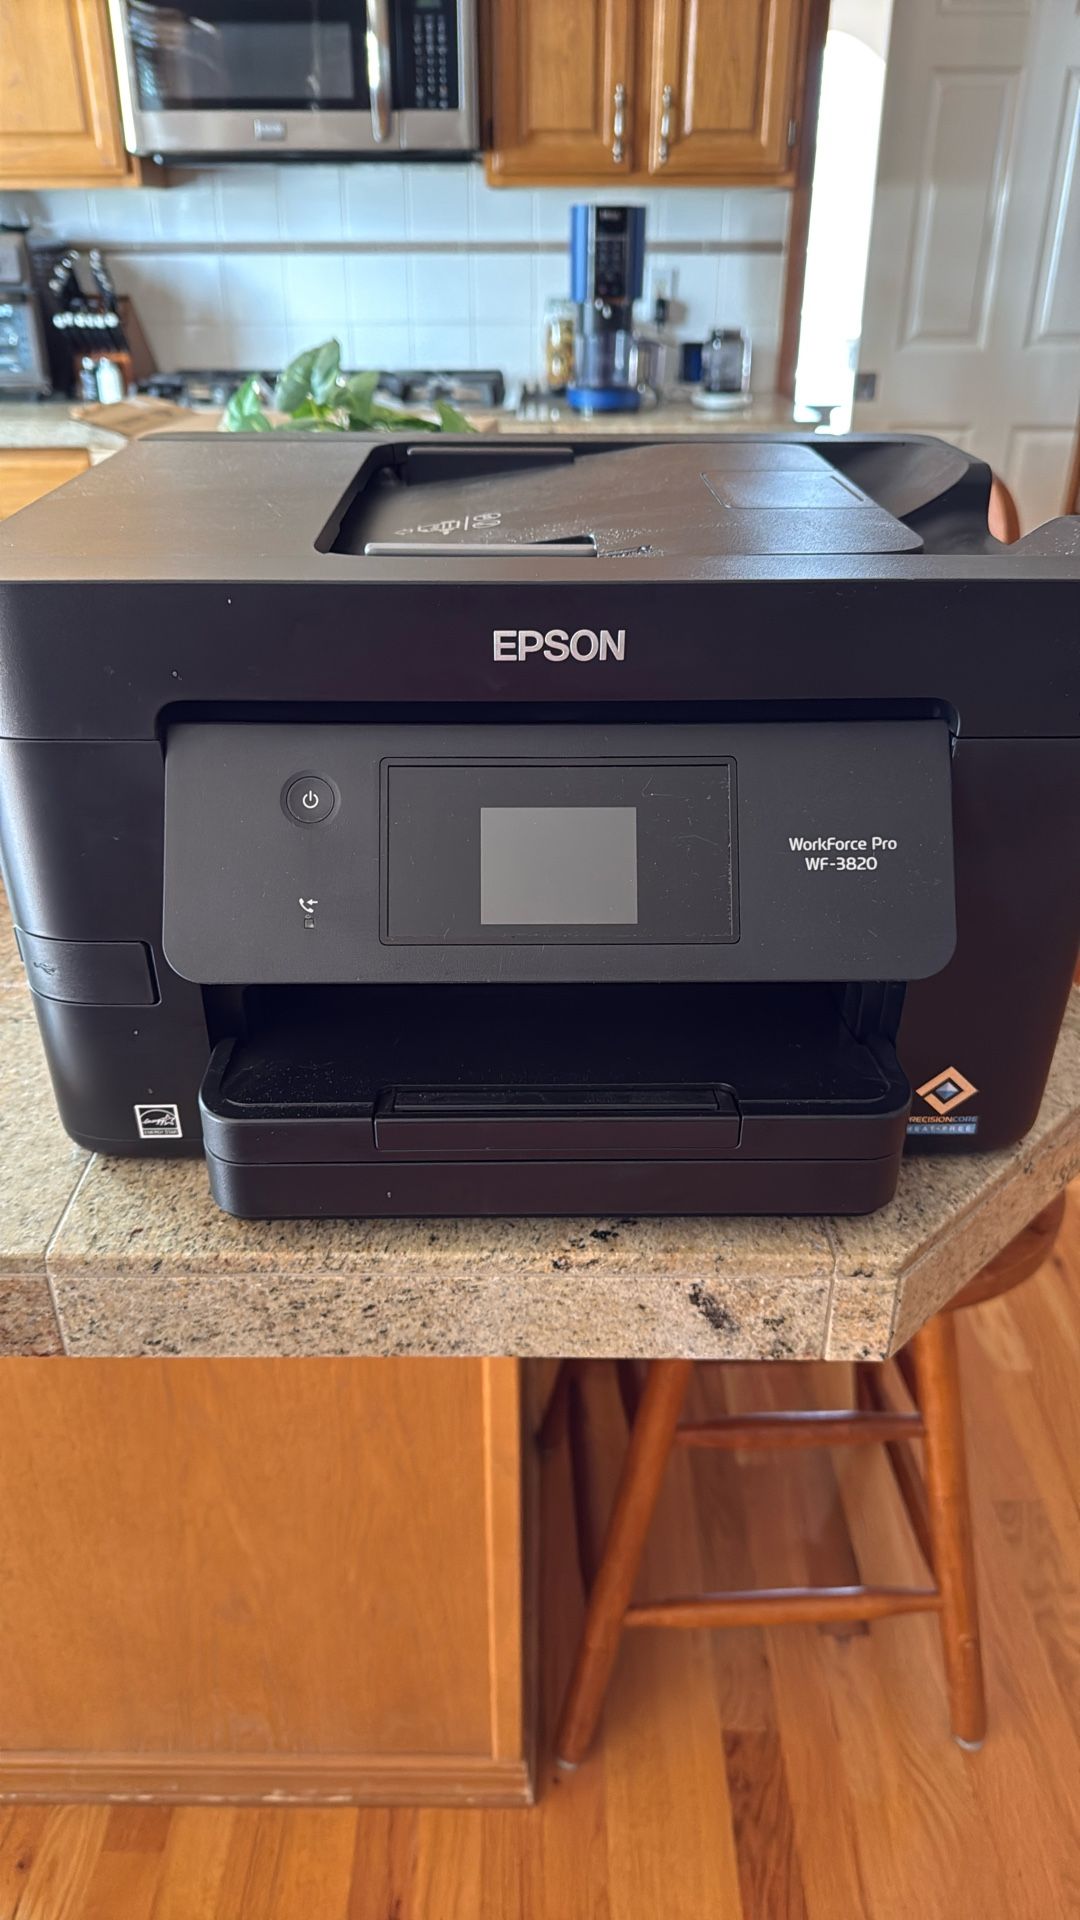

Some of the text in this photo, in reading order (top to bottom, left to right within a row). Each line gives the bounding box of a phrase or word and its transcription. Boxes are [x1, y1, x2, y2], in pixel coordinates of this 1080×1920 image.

[493, 629, 626, 662] EPSON
[788, 836, 898, 851] WorkForce Pro
[805, 856, 878, 871] WF-3820
[908, 1115, 978, 1123] RECISIONCORE
